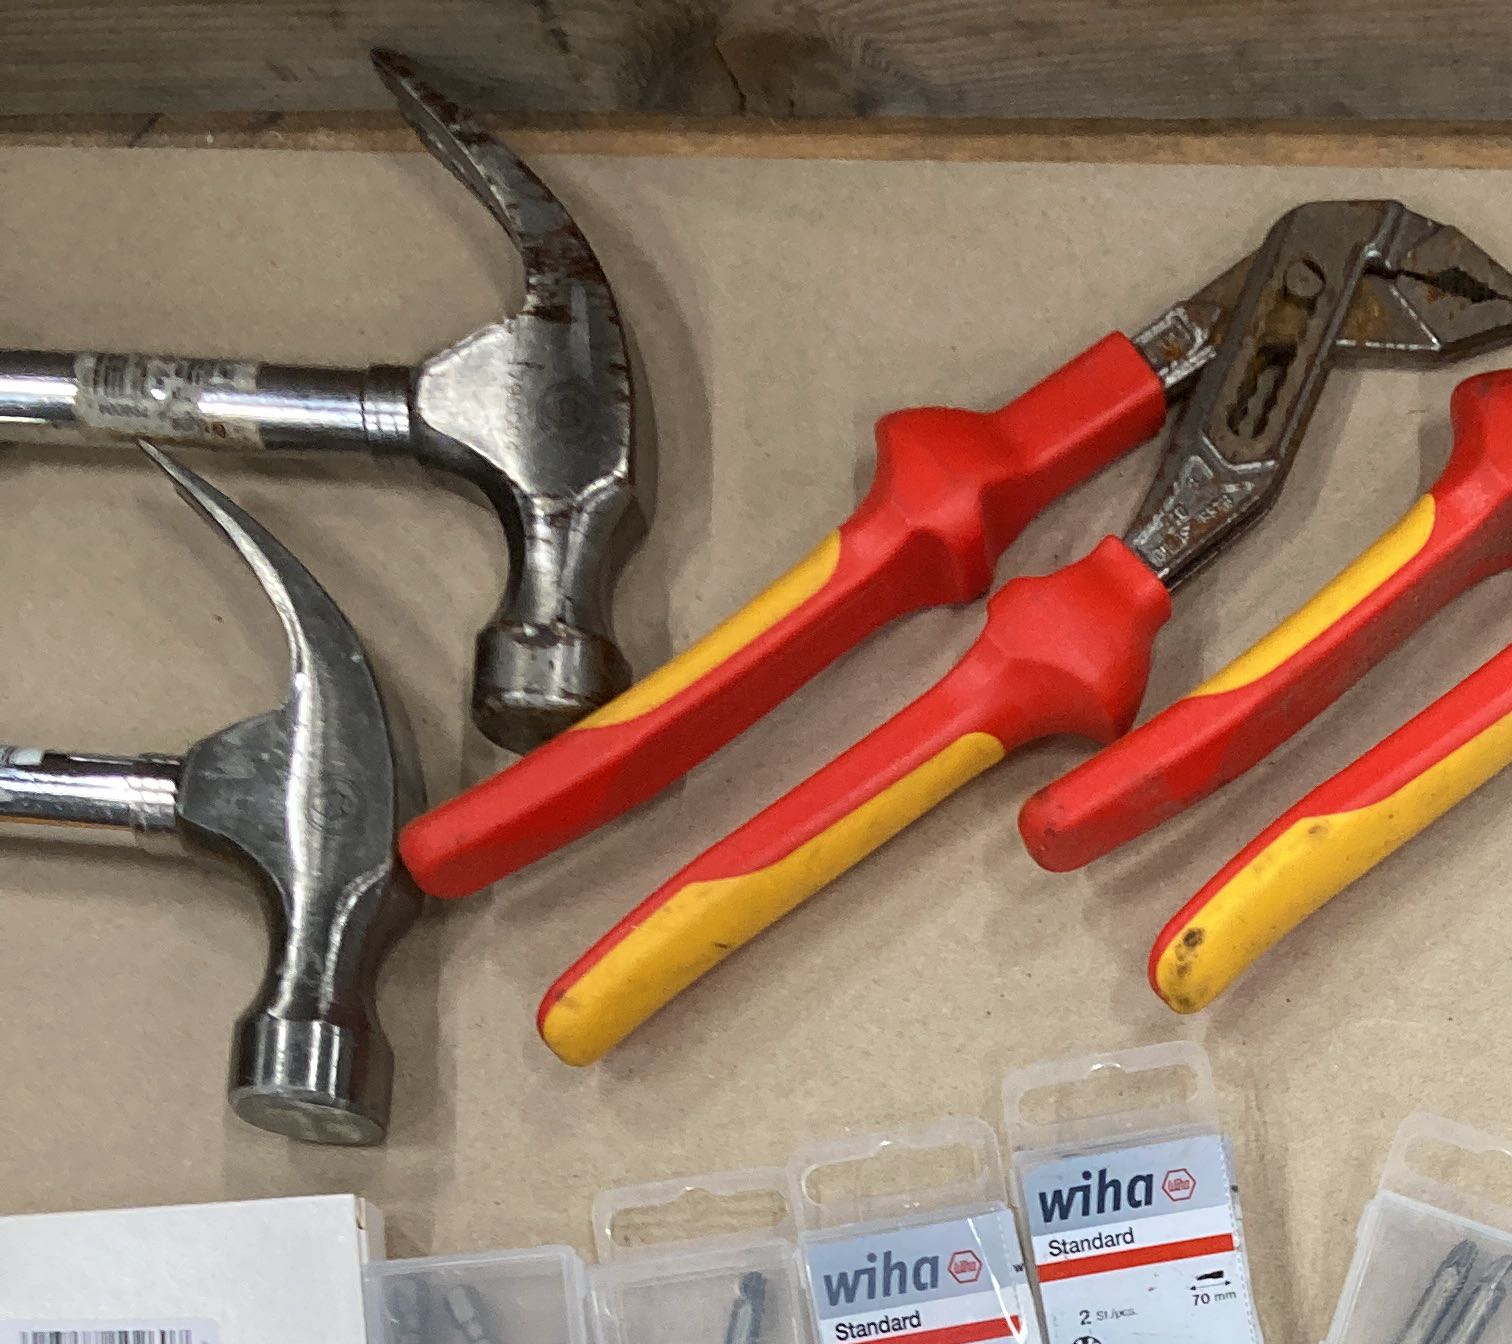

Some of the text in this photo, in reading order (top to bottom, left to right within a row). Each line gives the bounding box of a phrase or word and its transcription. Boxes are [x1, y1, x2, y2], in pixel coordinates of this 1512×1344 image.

[1038, 1167, 1154, 1224] wiha
[1047, 1226, 1136, 1257] Standard
[824, 1250, 941, 1308] wiha
[1192, 1289, 1238, 1307] 70 mm
[834, 1310, 923, 1342] Standard
[1079, 1309, 1092, 1326] 2
